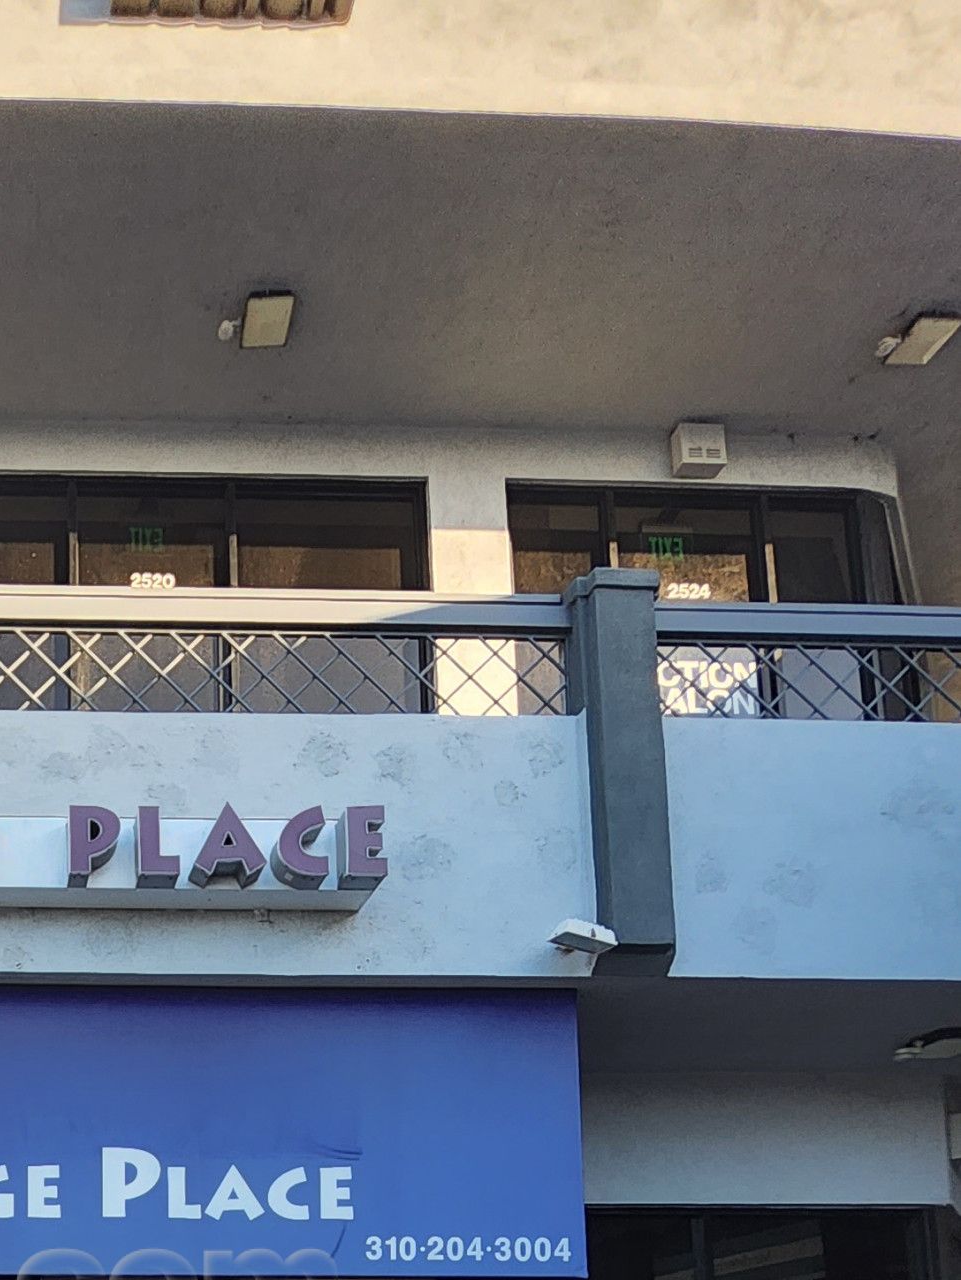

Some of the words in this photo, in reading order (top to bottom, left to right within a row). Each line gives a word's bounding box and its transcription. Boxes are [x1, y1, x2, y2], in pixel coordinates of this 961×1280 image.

[130, 572, 176, 589] 2520
[667, 582, 712, 600] 2524
[657, 660, 757, 690] CTION
[659, 686, 757, 716] ALON
[68, 801, 389, 880] PLACE
[101, 1146, 355, 1222] PLACE
